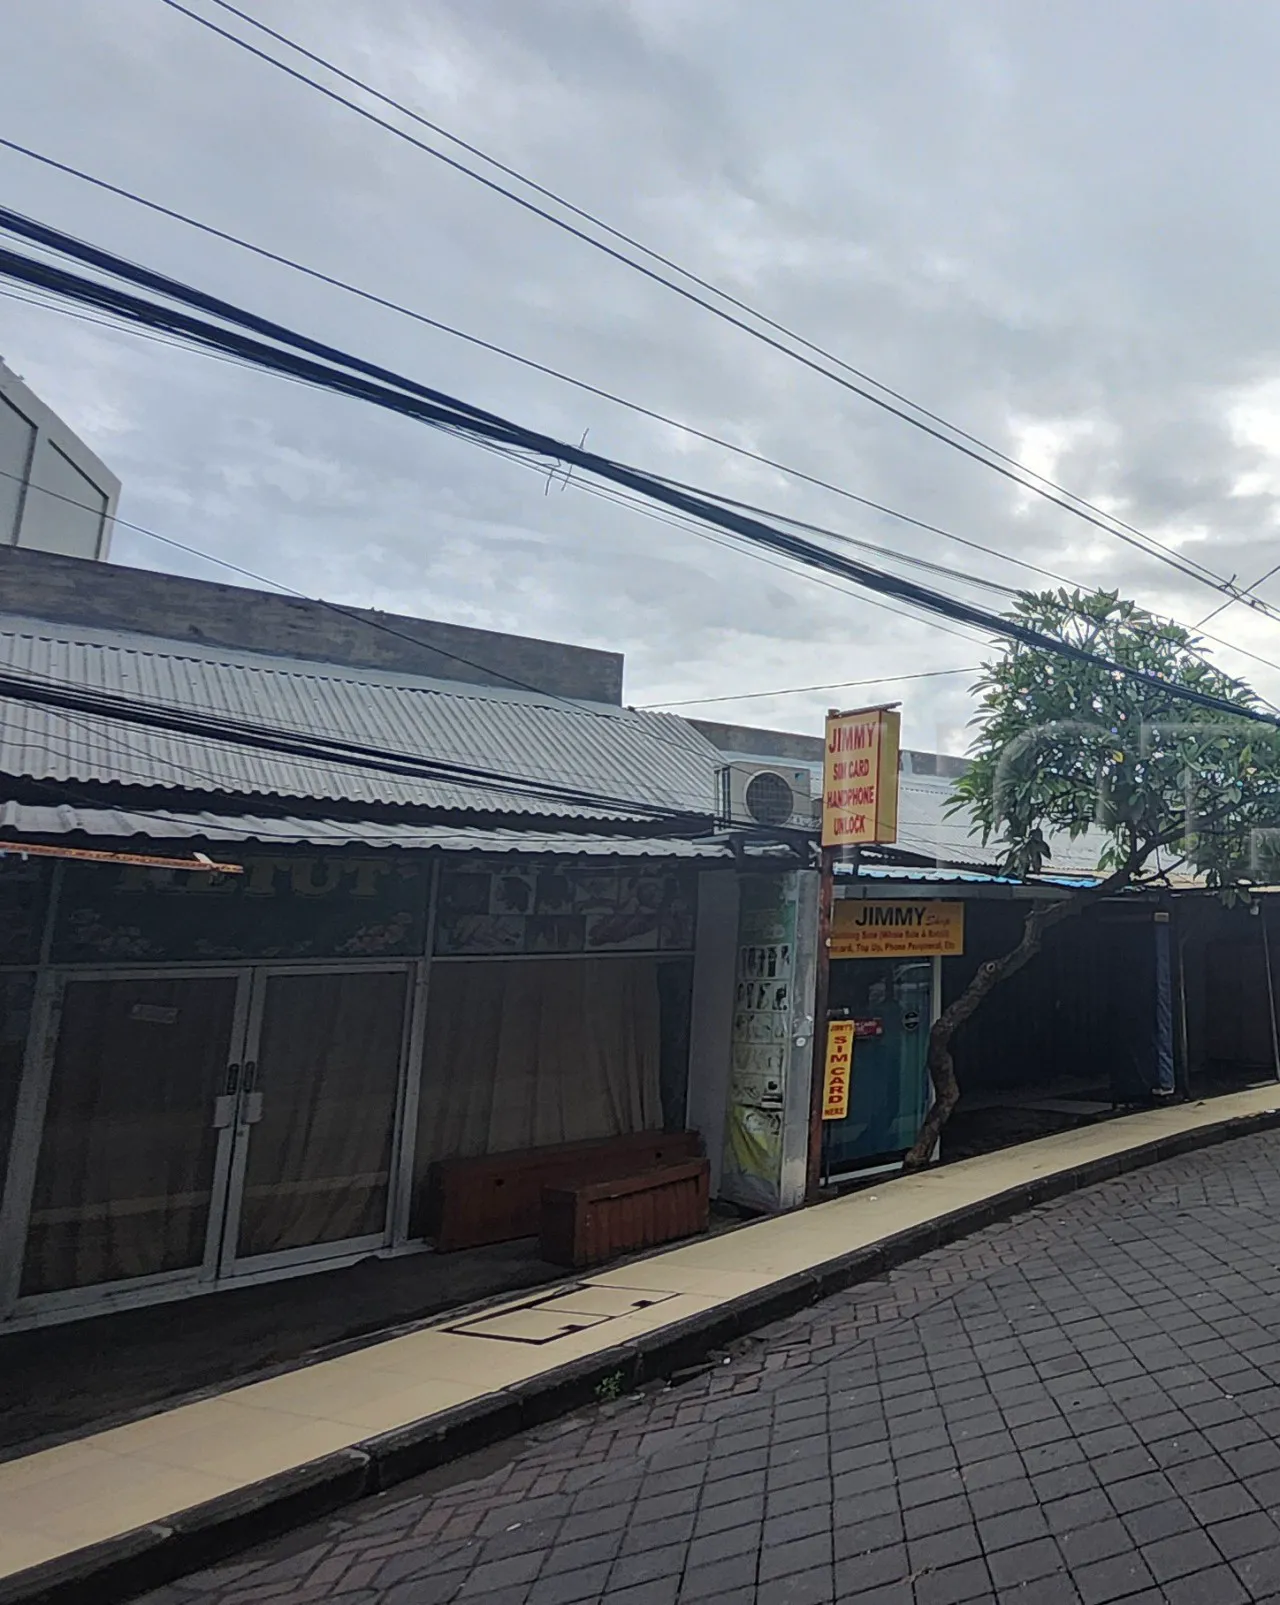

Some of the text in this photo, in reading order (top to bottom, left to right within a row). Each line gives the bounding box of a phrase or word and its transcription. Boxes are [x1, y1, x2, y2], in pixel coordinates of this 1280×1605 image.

[828, 723, 876, 754] JIMMY
[833, 758, 870, 781] SIM CARD
[826, 786, 875, 809] HANDPHONE
[833, 815, 866, 836] UNLOCK
[855, 907, 926, 926] JIMMY
[828, 1036, 848, 1104] SIM CARD
